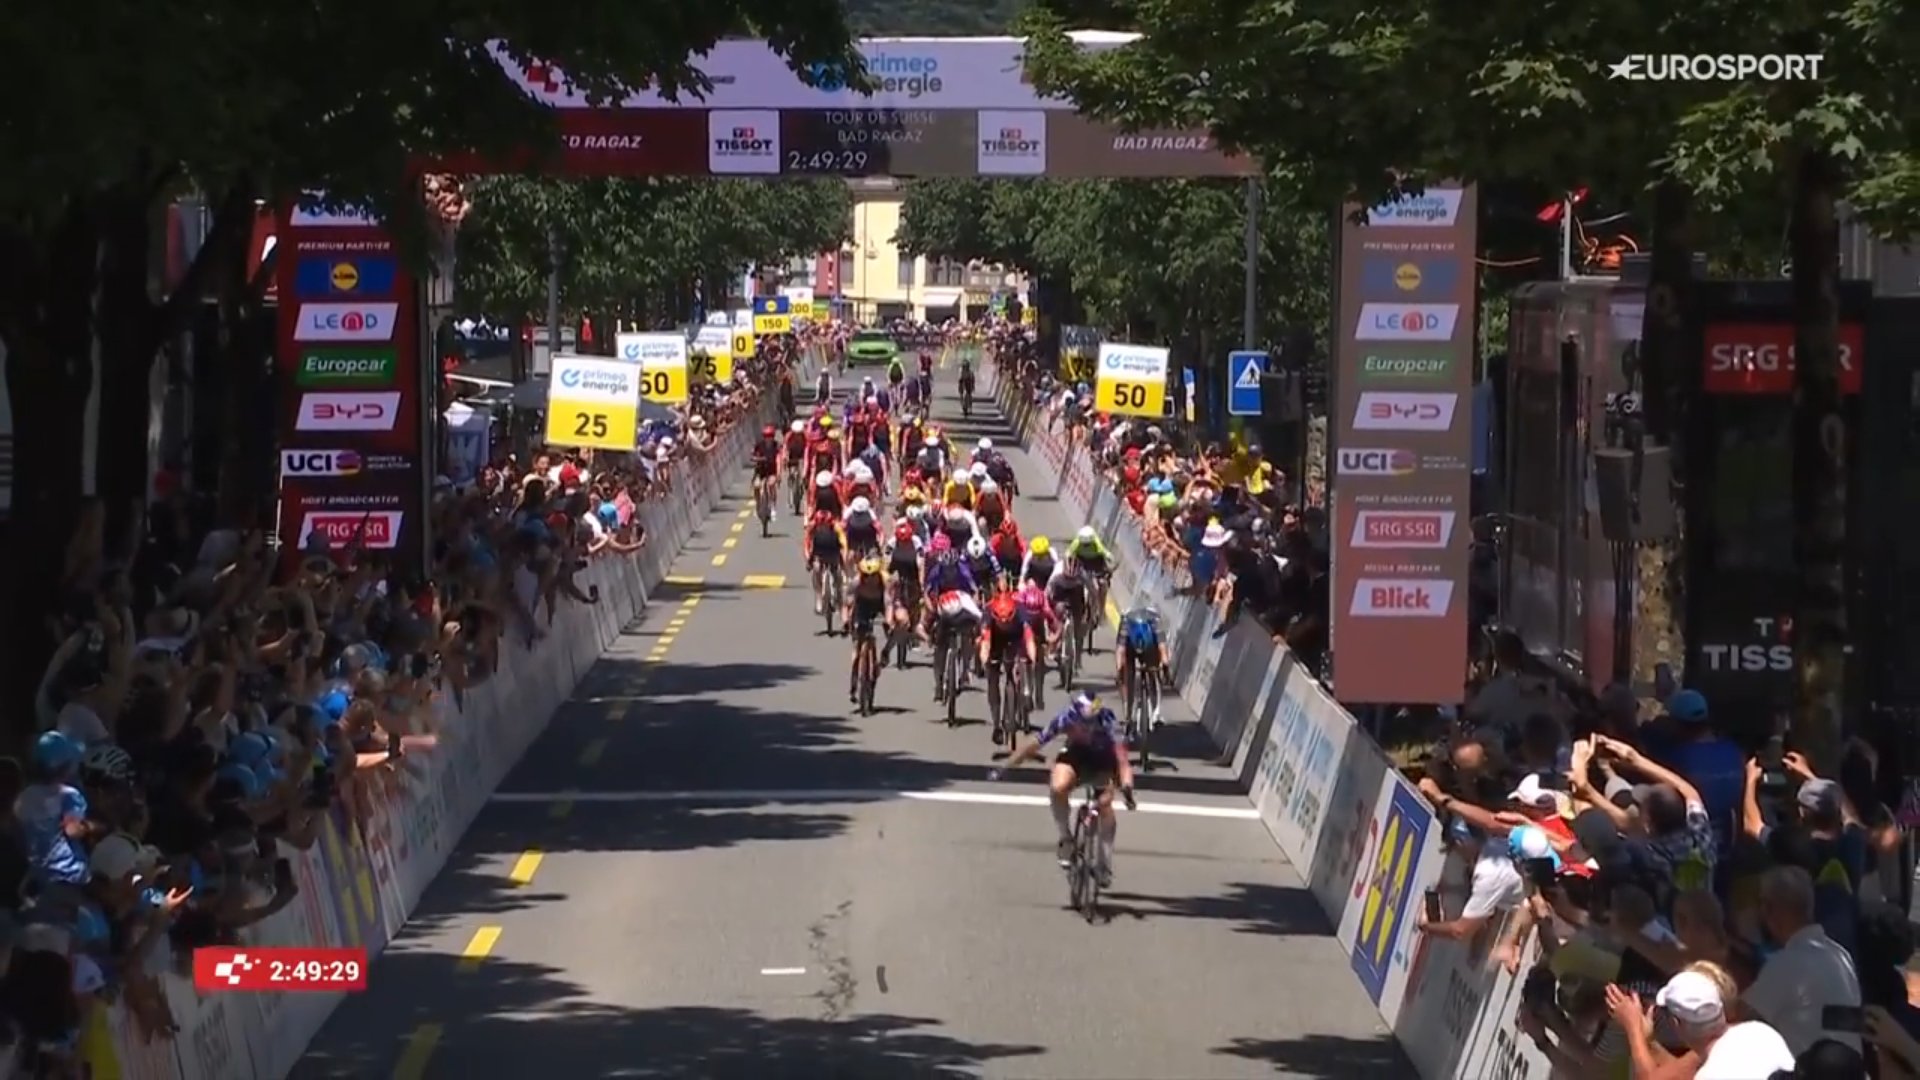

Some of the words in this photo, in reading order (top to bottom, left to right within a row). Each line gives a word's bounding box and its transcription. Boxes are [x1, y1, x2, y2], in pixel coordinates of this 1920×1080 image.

[825, 112, 862, 124] TOUR
[868, 112, 888, 123] DE
[891, 112, 935, 124] SUISSE
[584, 135, 642, 148] RAGAZ
[838, 130, 867, 142] BAD
[872, 130, 923, 142] RAGAZ
[1112, 137, 1147, 149] BAD
[1151, 137, 1209, 149] RAGAZ
[715, 139, 773, 151] TISSOT
[983, 140, 1040, 152] TISSOT
[788, 151, 868, 169] 2:49:29
[763, 319, 782, 328] 150
[1365, 356, 1446, 374] Europcar
[1712, 345, 1778, 371] SRG
[306, 357, 387, 375] Europcar
[582, 381, 628, 395] energie
[1114, 384, 1146, 408] 50
[313, 404, 383, 418] BYD
[1370, 404, 1440, 419] BYD
[574, 412, 607, 438] 25
[287, 454, 332, 472] UCI
[1343, 453, 1387, 470] UCI
[1369, 522, 1402, 536] SRG
[1406, 522, 1436, 536] SSR
[1371, 587, 1430, 608] Blick
[1702, 644, 1793, 671] TISS
